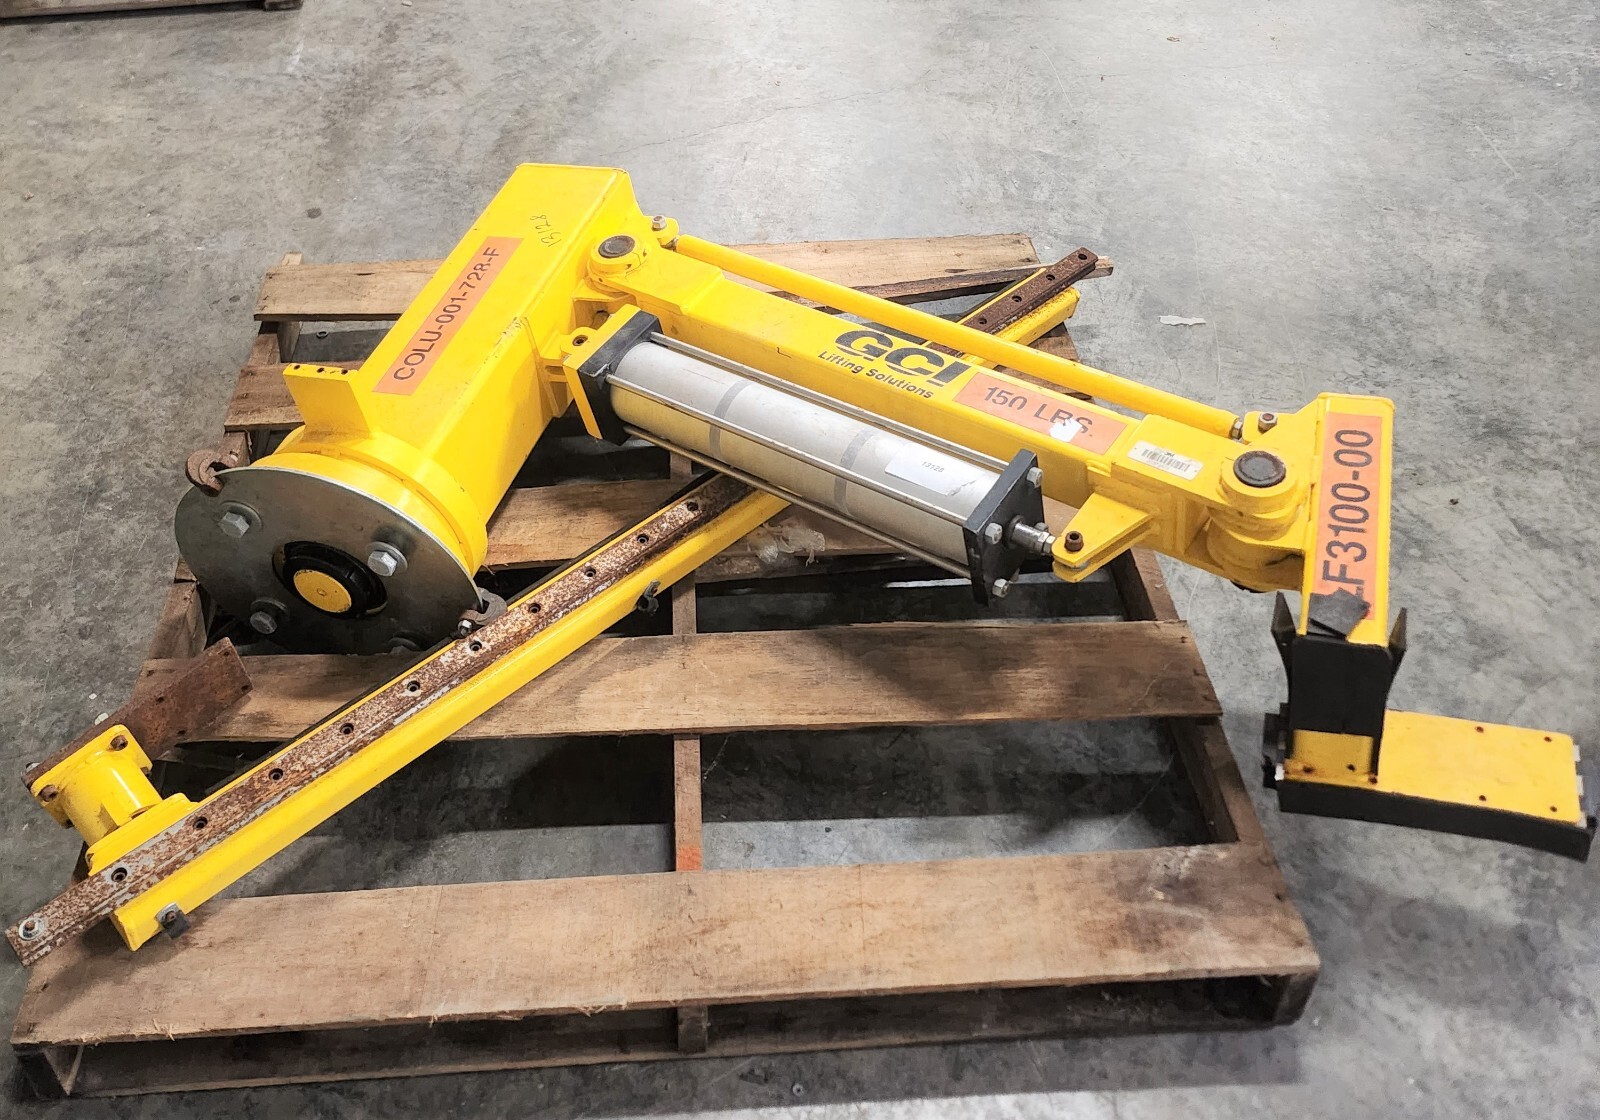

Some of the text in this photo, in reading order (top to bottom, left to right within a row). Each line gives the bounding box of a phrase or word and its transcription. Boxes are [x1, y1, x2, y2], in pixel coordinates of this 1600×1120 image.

[393, 247, 500, 381] COLU-001-728-F
[817, 350, 934, 399] Lifting Solutions
[835, 330, 971, 388] GCI
[983, 386, 1028, 411] 150
[921, 461, 945, 473] 13128
[1322, 429, 1374, 600] F3100-00
